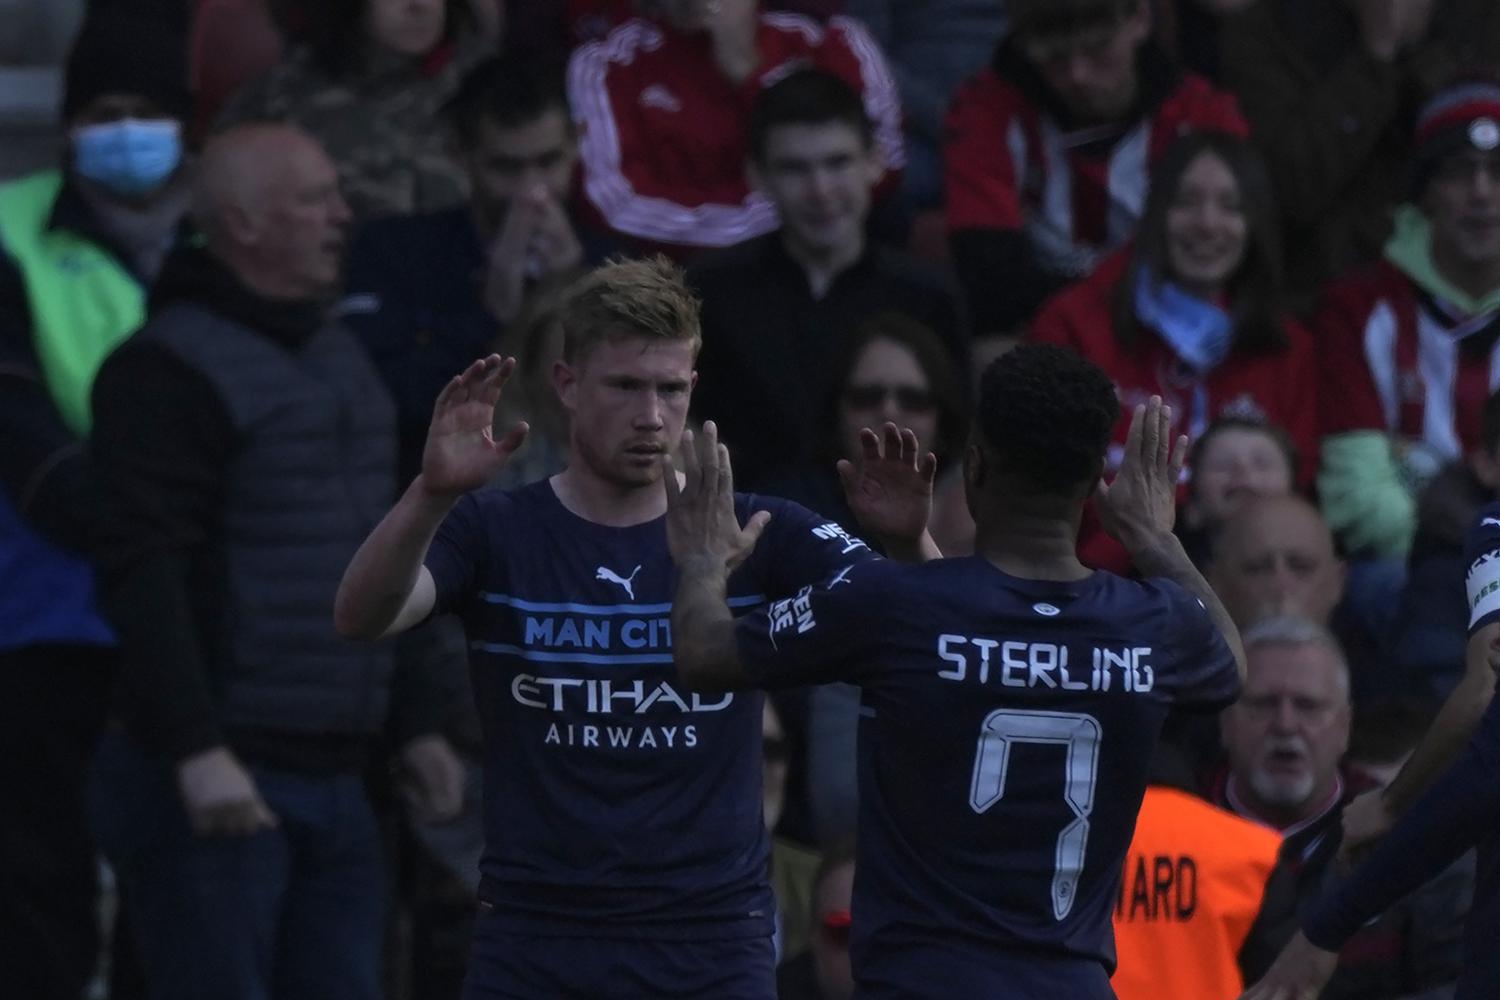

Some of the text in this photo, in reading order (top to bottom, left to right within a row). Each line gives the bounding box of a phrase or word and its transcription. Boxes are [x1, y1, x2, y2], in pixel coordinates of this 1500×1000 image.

[524, 616, 672, 648] MAN CIT
[937, 634, 1153, 692] STERLING
[545, 722, 697, 748] AIRWAYS
[969, 708, 1102, 921] 7
[1117, 856, 1197, 921] ARD
